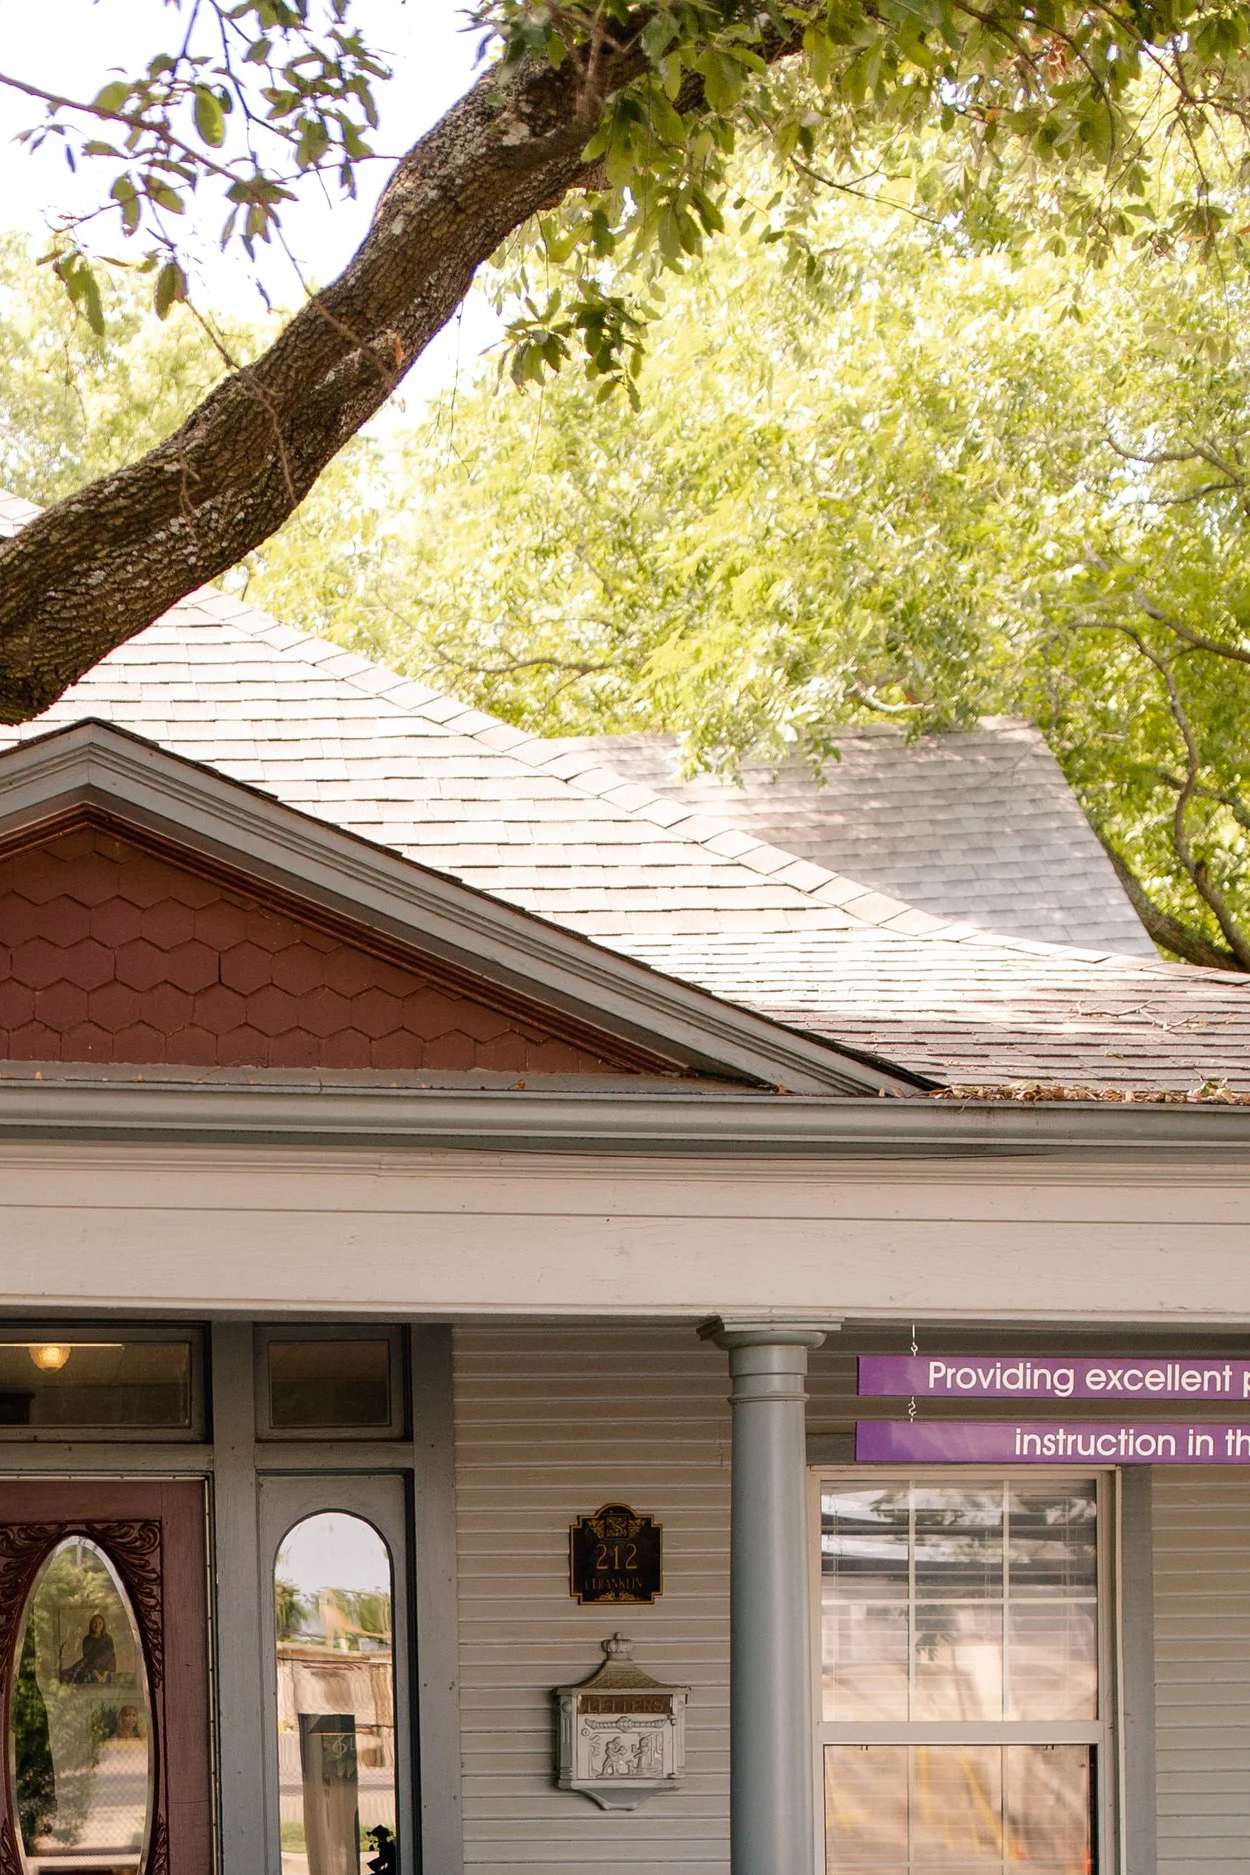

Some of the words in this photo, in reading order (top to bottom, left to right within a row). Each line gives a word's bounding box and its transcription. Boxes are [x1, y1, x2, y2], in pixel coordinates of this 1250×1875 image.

[928, 1361, 1075, 1397] Providing
[1085, 1364, 1233, 1392] excellent
[1015, 1428, 1176, 1457] instruction
[1188, 1429, 1214, 1457] in
[595, 1543, 638, 1570] 212
[592, 1576, 642, 1590] FRANKLIN
[587, 1698, 664, 1713] LETTERS
